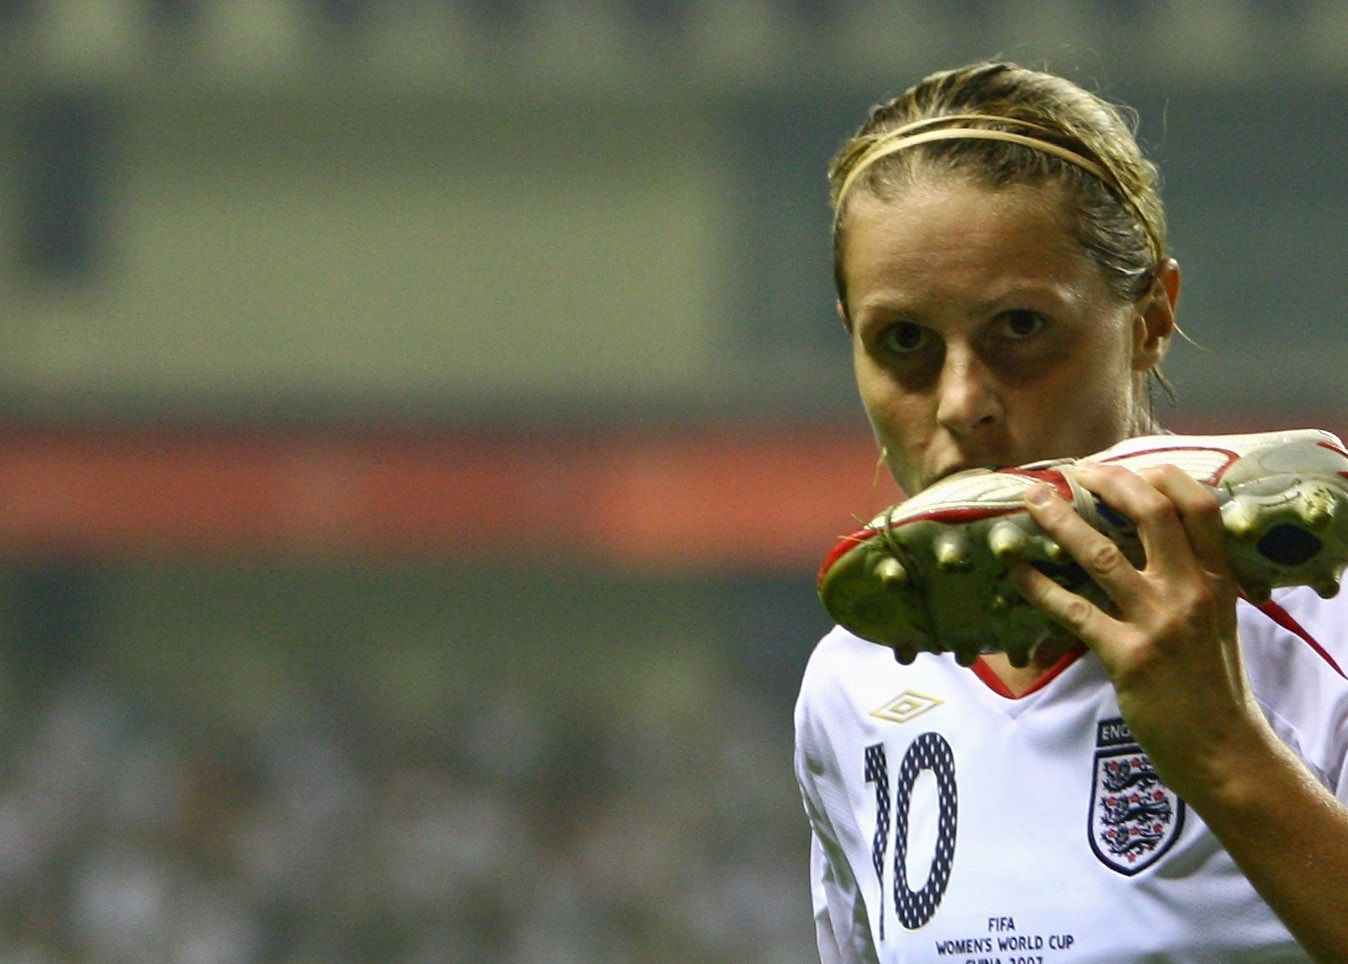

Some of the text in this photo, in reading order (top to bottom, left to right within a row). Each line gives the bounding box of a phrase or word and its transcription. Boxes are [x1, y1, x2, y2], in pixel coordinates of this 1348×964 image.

[864, 731, 958, 940] 10
[988, 917, 1015, 932] FIFA
[935, 934, 1074, 955] WOMEN'S WORLD CUP
